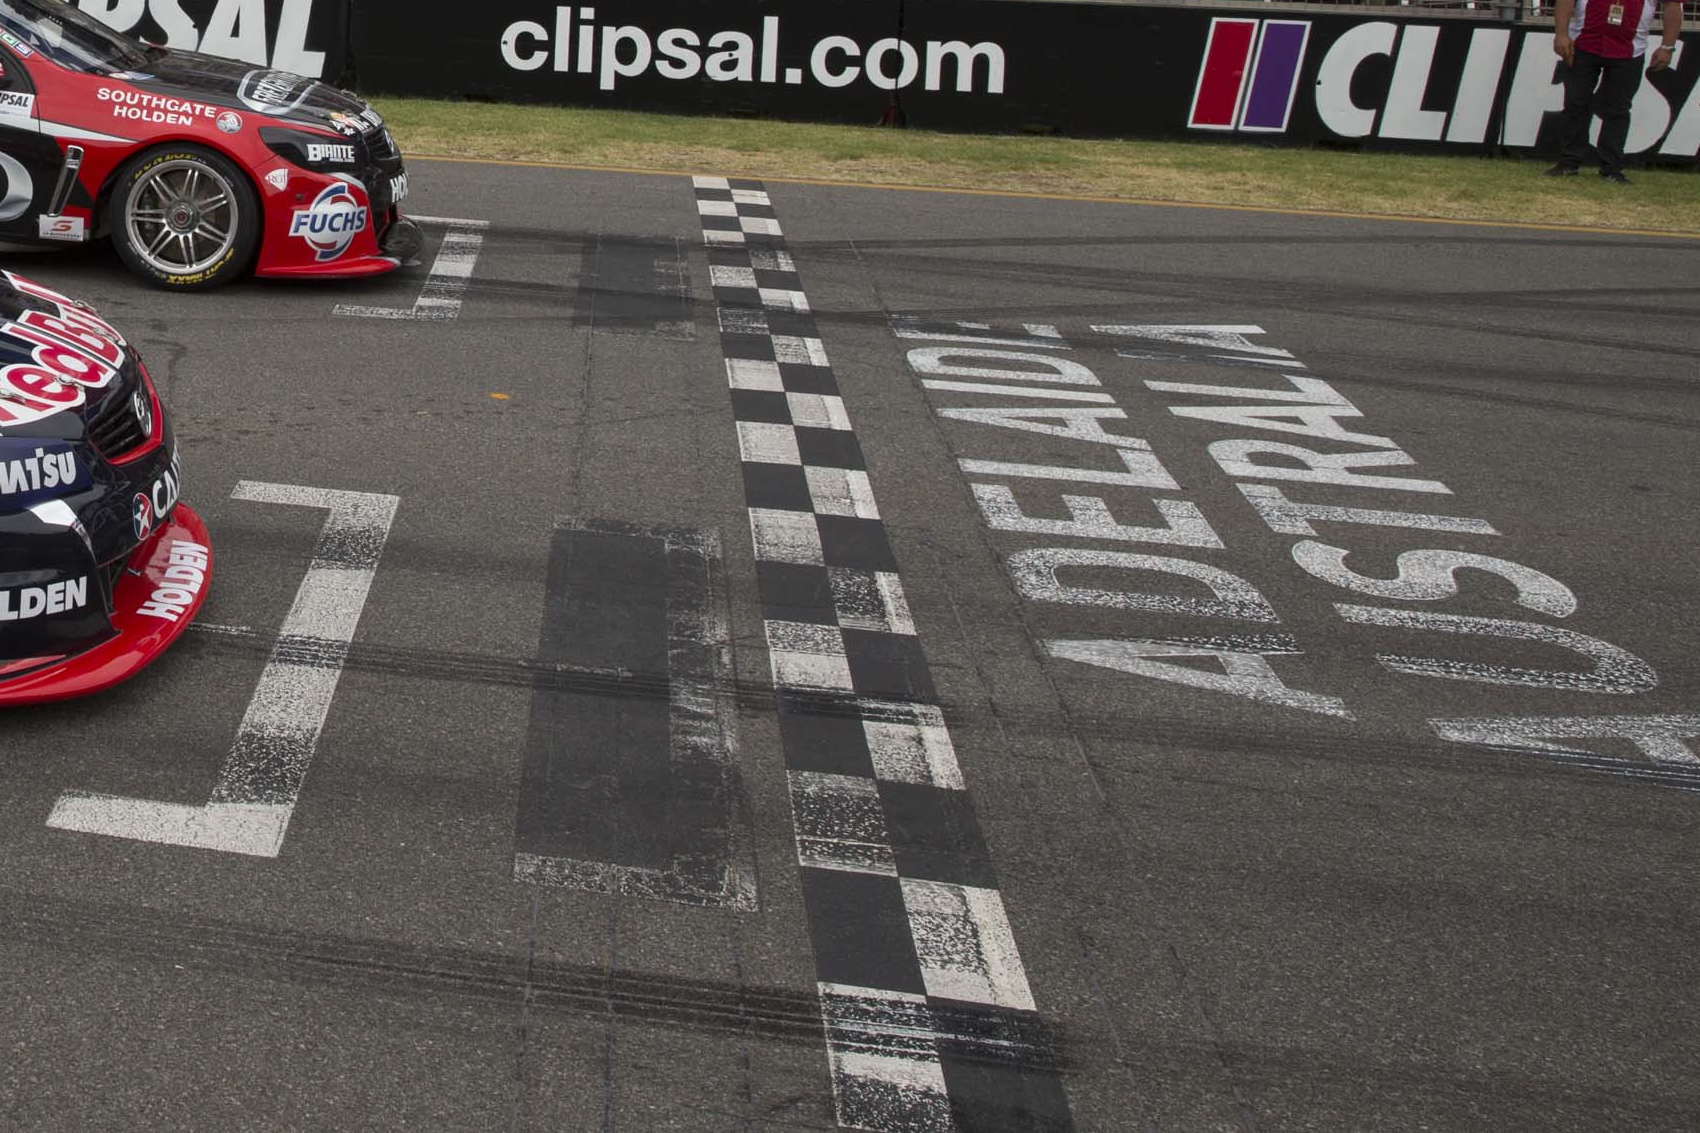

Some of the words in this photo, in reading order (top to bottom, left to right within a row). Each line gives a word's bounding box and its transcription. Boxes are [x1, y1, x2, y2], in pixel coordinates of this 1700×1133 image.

[500, 5, 1006, 94] clipsal.com
[97, 87, 217, 118] SOUTHGATE
[113, 104, 193, 127] HOLDEN
[292, 208, 366, 234] FUCHS
[136, 539, 209, 623] HOLDEN
